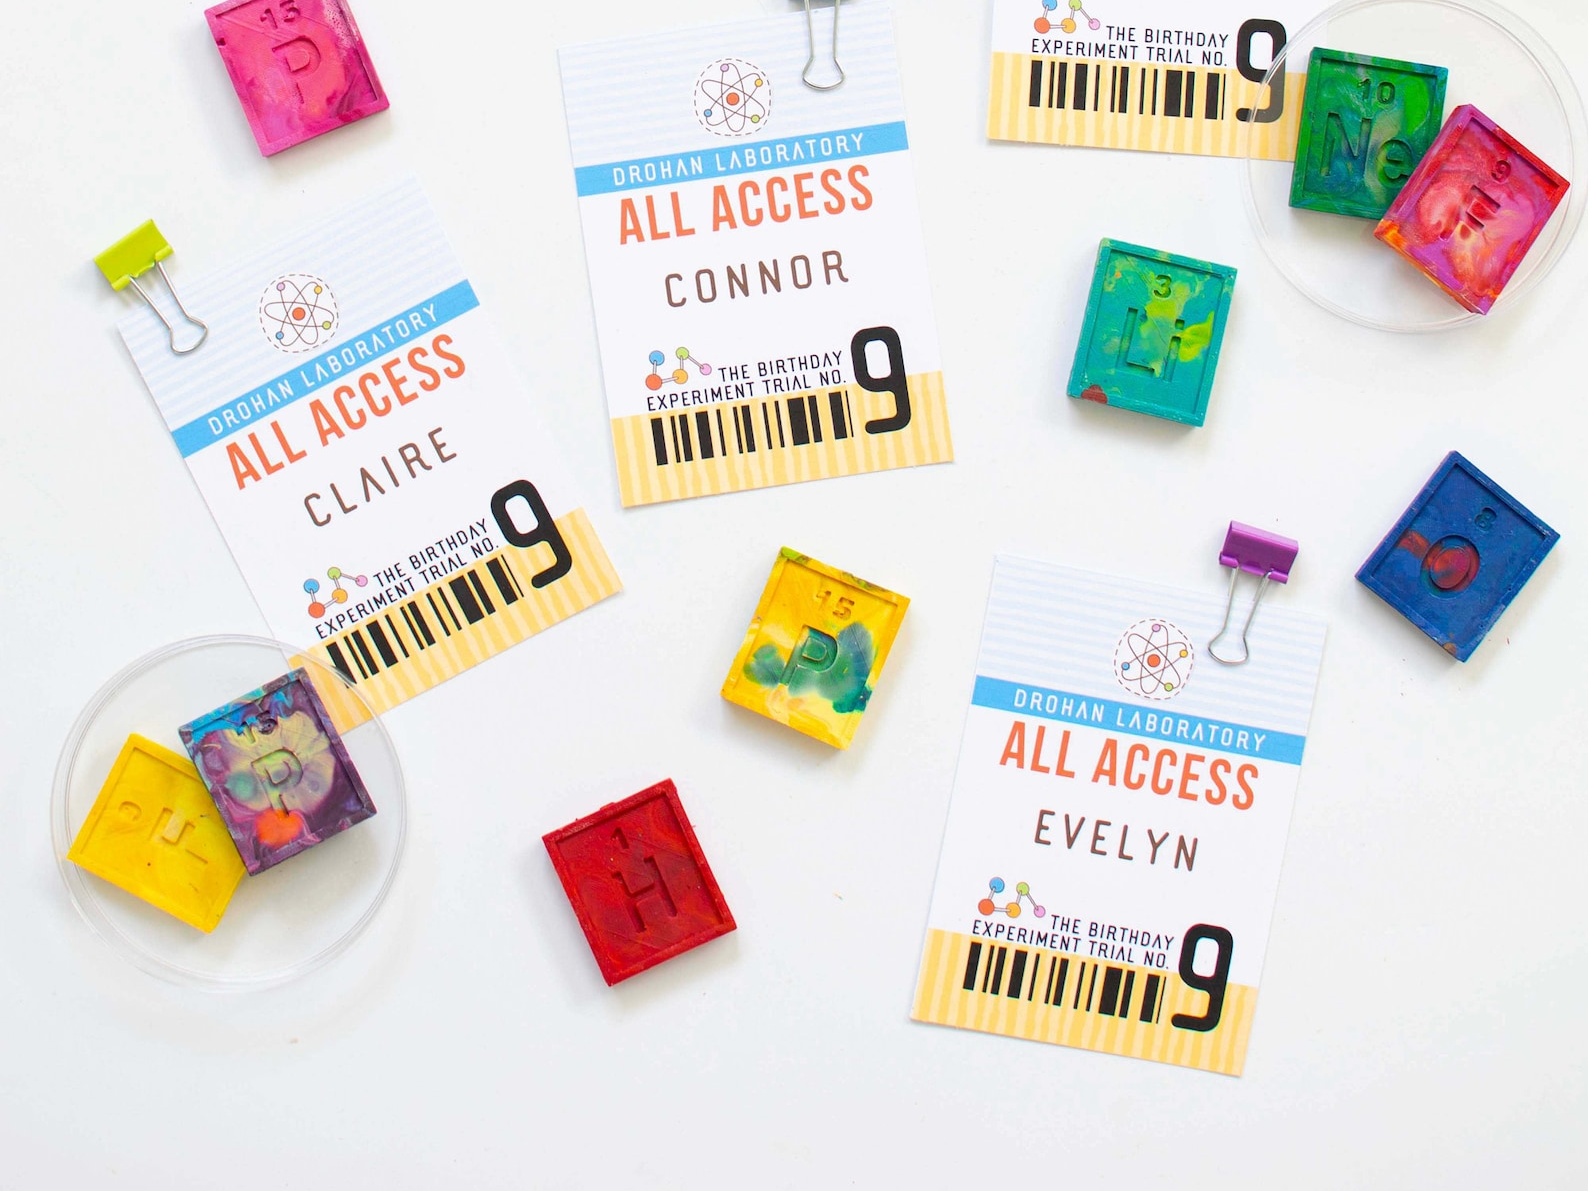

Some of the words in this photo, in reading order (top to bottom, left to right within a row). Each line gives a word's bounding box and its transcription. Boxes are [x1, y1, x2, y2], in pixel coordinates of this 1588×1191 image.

[1032, 39, 1138, 61] EXPERIMENT
[1146, 46, 1194, 63] TRIAL
[1202, 51, 1227, 67] NO.
[1106, 25, 1135, 43] THE
[1145, 28, 1228, 48] BIRTHDAY
[272, 35, 321, 105] P
[1236, 19, 1286, 123] 9
[1358, 78, 1395, 104] 10
[613, 157, 703, 186] DROHAN
[716, 133, 864, 172] LABORATORY
[1320, 112, 1414, 188] Ne
[620, 191, 695, 245] ALL
[712, 165, 873, 232] ACCESS
[1439, 185, 1501, 241] F
[665, 250, 848, 308] CONNOR
[1153, 274, 1172, 299] 3
[208, 384, 294, 435] DROHAN
[300, 303, 438, 387] LABORATORY
[718, 364, 750, 382] THE
[758, 351, 842, 377] BIRTHDAY
[1116, 307, 1185, 383] Li
[225, 420, 307, 491] ALL
[308, 333, 465, 447] ACCESS
[646, 381, 754, 411] EXPERIMENT
[764, 374, 812, 394] TRIAL
[820, 368, 846, 385] NO.
[850, 326, 912, 435] 9
[304, 427, 457, 527] CLAIRE
[490, 479, 572, 589] 9
[1474, 507, 1497, 531] 8
[373, 562, 406, 587] THE
[409, 519, 487, 567] BIRTHDAY
[1420, 535, 1480, 599] O
[316, 582, 416, 640] EXPERIMENT
[419, 556, 466, 585] TRIAL
[470, 538, 499, 560] NO.
[816, 590, 855, 620] 15
[779, 624, 839, 686] P
[1014, 689, 1104, 723] DROHAN
[1117, 707, 1267, 752] LABORATORY
[252, 746, 303, 816] P
[1000, 720, 1076, 778] ALL
[1091, 738, 1259, 810] ACCESS
[611, 827, 629, 849] 1
[1034, 809, 1198, 872] EVELYN
[611, 855, 678, 933] H
[972, 919, 1080, 952] EXPERIMENT
[1088, 940, 1136, 964] TRIAL
[1143, 950, 1169, 970] NO.
[1051, 914, 1081, 935] THE
[1088, 921, 1174, 950] BIRTHDAY
[1172, 923, 1234, 1032] 9
